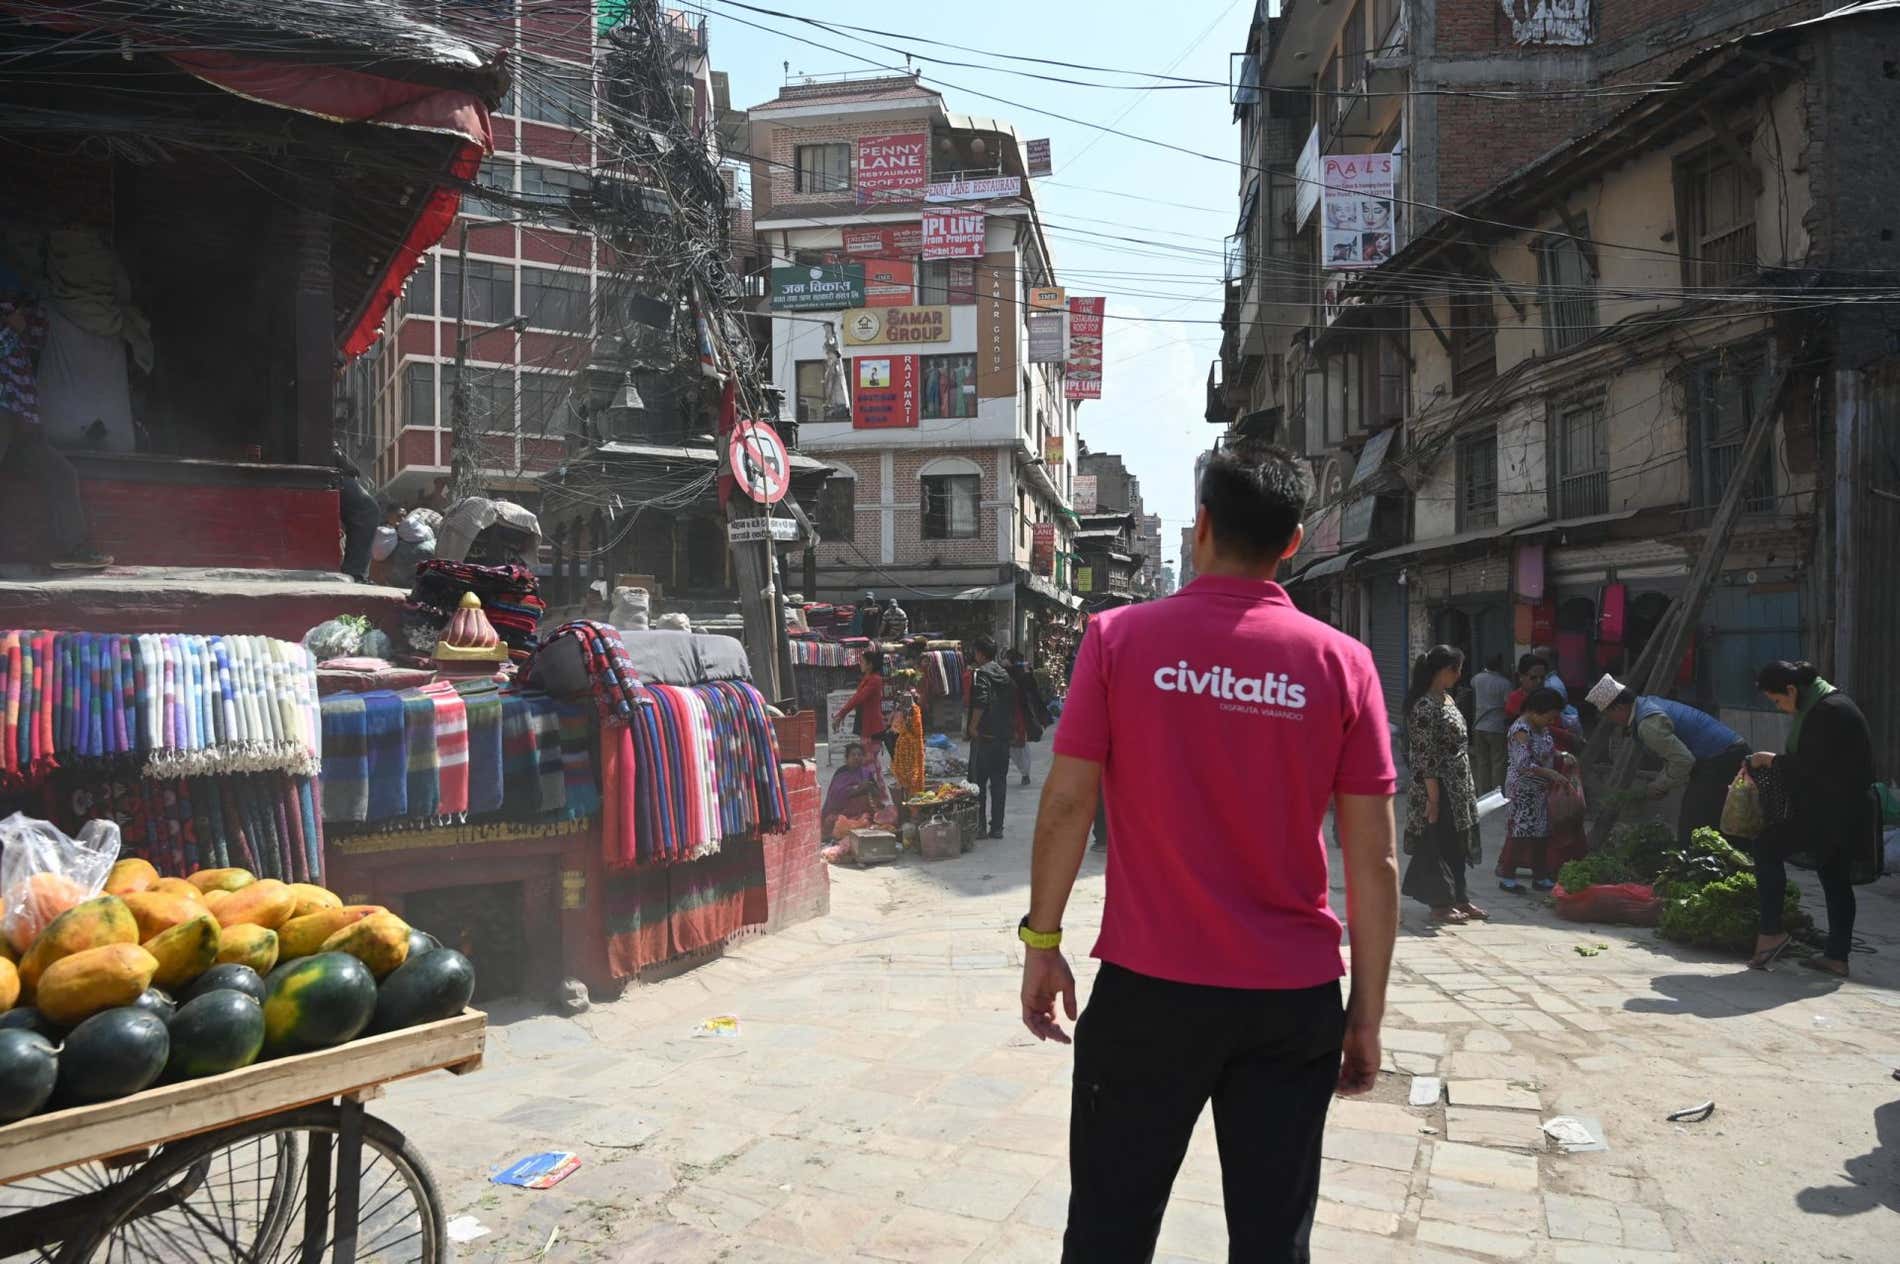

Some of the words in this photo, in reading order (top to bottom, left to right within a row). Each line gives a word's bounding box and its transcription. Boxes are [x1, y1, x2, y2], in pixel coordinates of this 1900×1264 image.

[860, 144, 922, 157] PENNY
[860, 155, 921, 170] LANE
[860, 169, 921, 178] RESTAURANT
[860, 179, 895, 187] ROOF
[897, 177, 922, 185] TOP
[950, 182, 970, 195] LANE
[973, 177, 1020, 193] RESTAURANT
[922, 217, 947, 236] IPL
[950, 215, 984, 235] LIVE
[992, 271, 1000, 319] SAMAR
[887, 308, 943, 326] SAMAR
[887, 326, 943, 341] GROUP
[904, 356, 912, 423] RAJAMATI
[1153, 660, 1306, 709] civitatis
[1219, 703, 1259, 715] DISFRUTA
[1261, 709, 1303, 721] VIAJANDO
